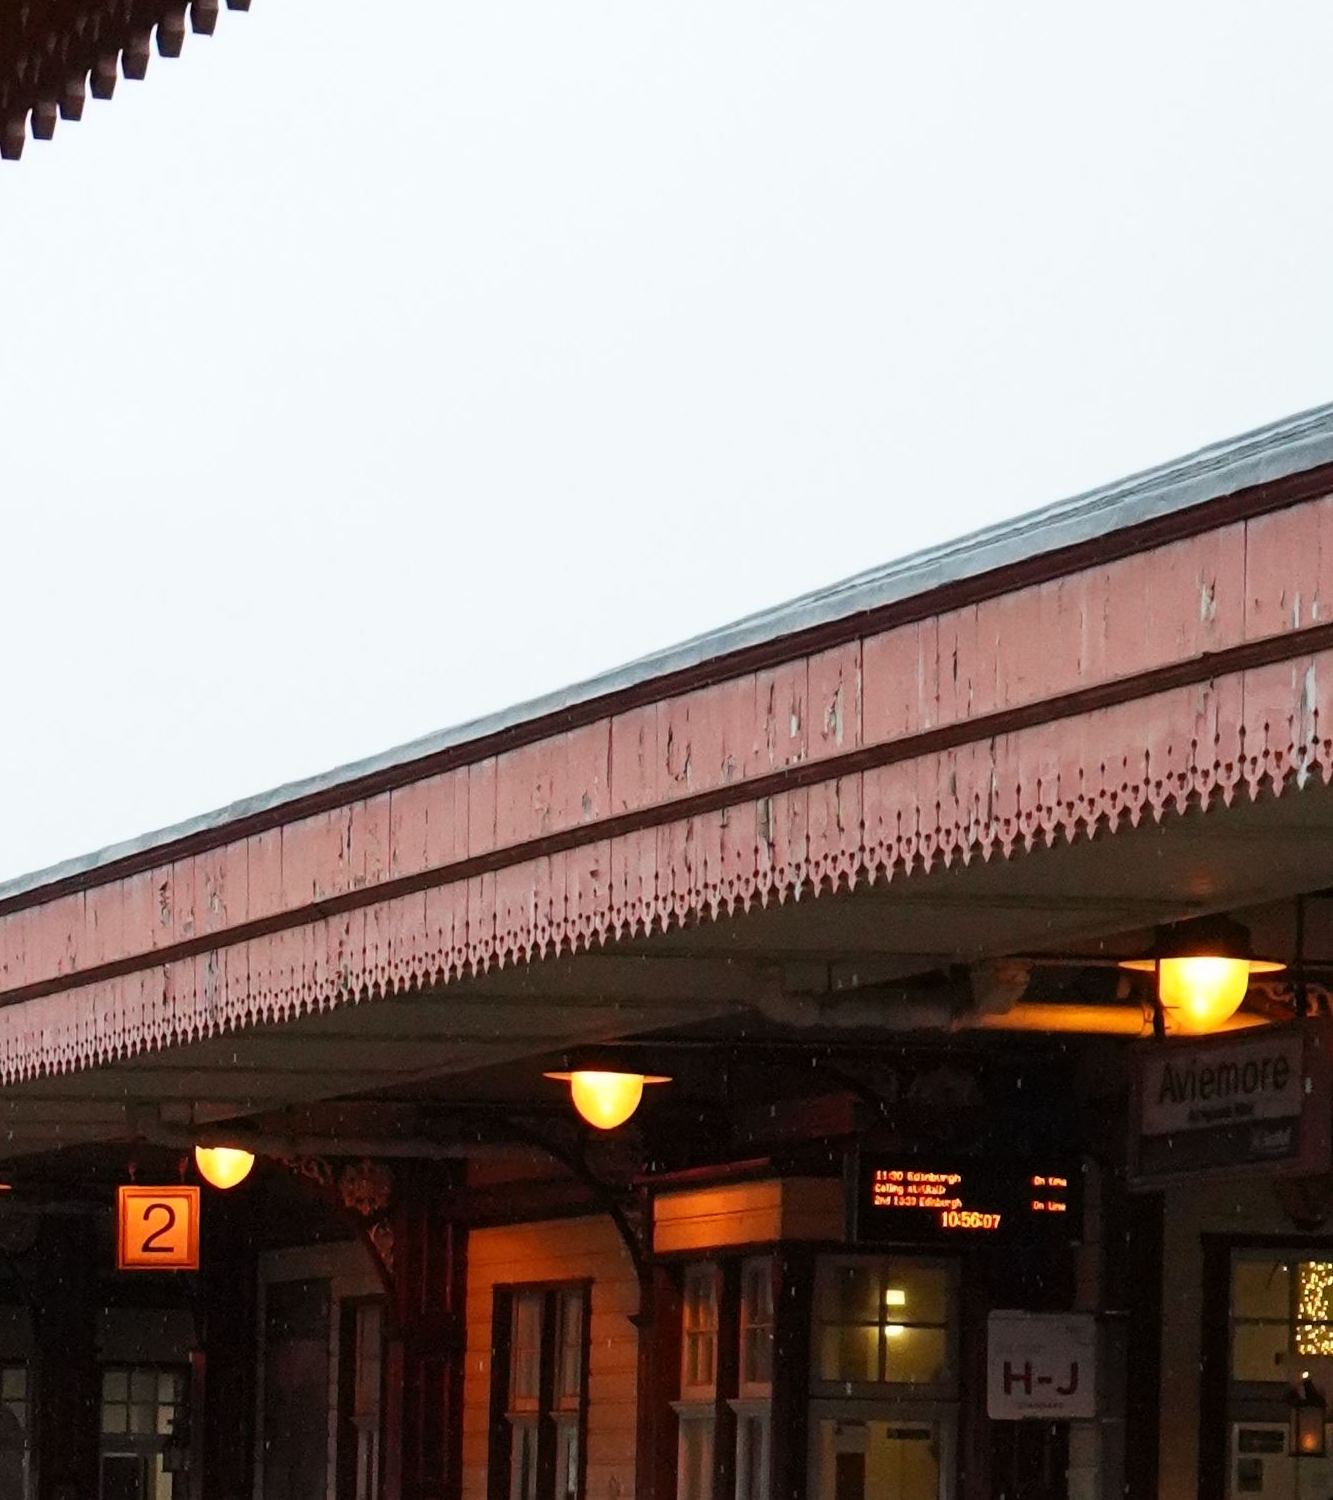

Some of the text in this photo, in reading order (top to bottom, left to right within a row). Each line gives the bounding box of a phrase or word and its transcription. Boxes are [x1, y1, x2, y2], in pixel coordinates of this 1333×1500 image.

[1158, 1055, 1290, 1105] Aviemore
[907, 1171, 961, 1185] Edinburgh
[874, 1183, 904, 1195] Calling
[919, 1197, 962, 1210] Edinburgh
[141, 1203, 176, 1254] 2
[942, 1210, 1001, 1229] 10:56:07
[1003, 1361, 1079, 1395] H-J
